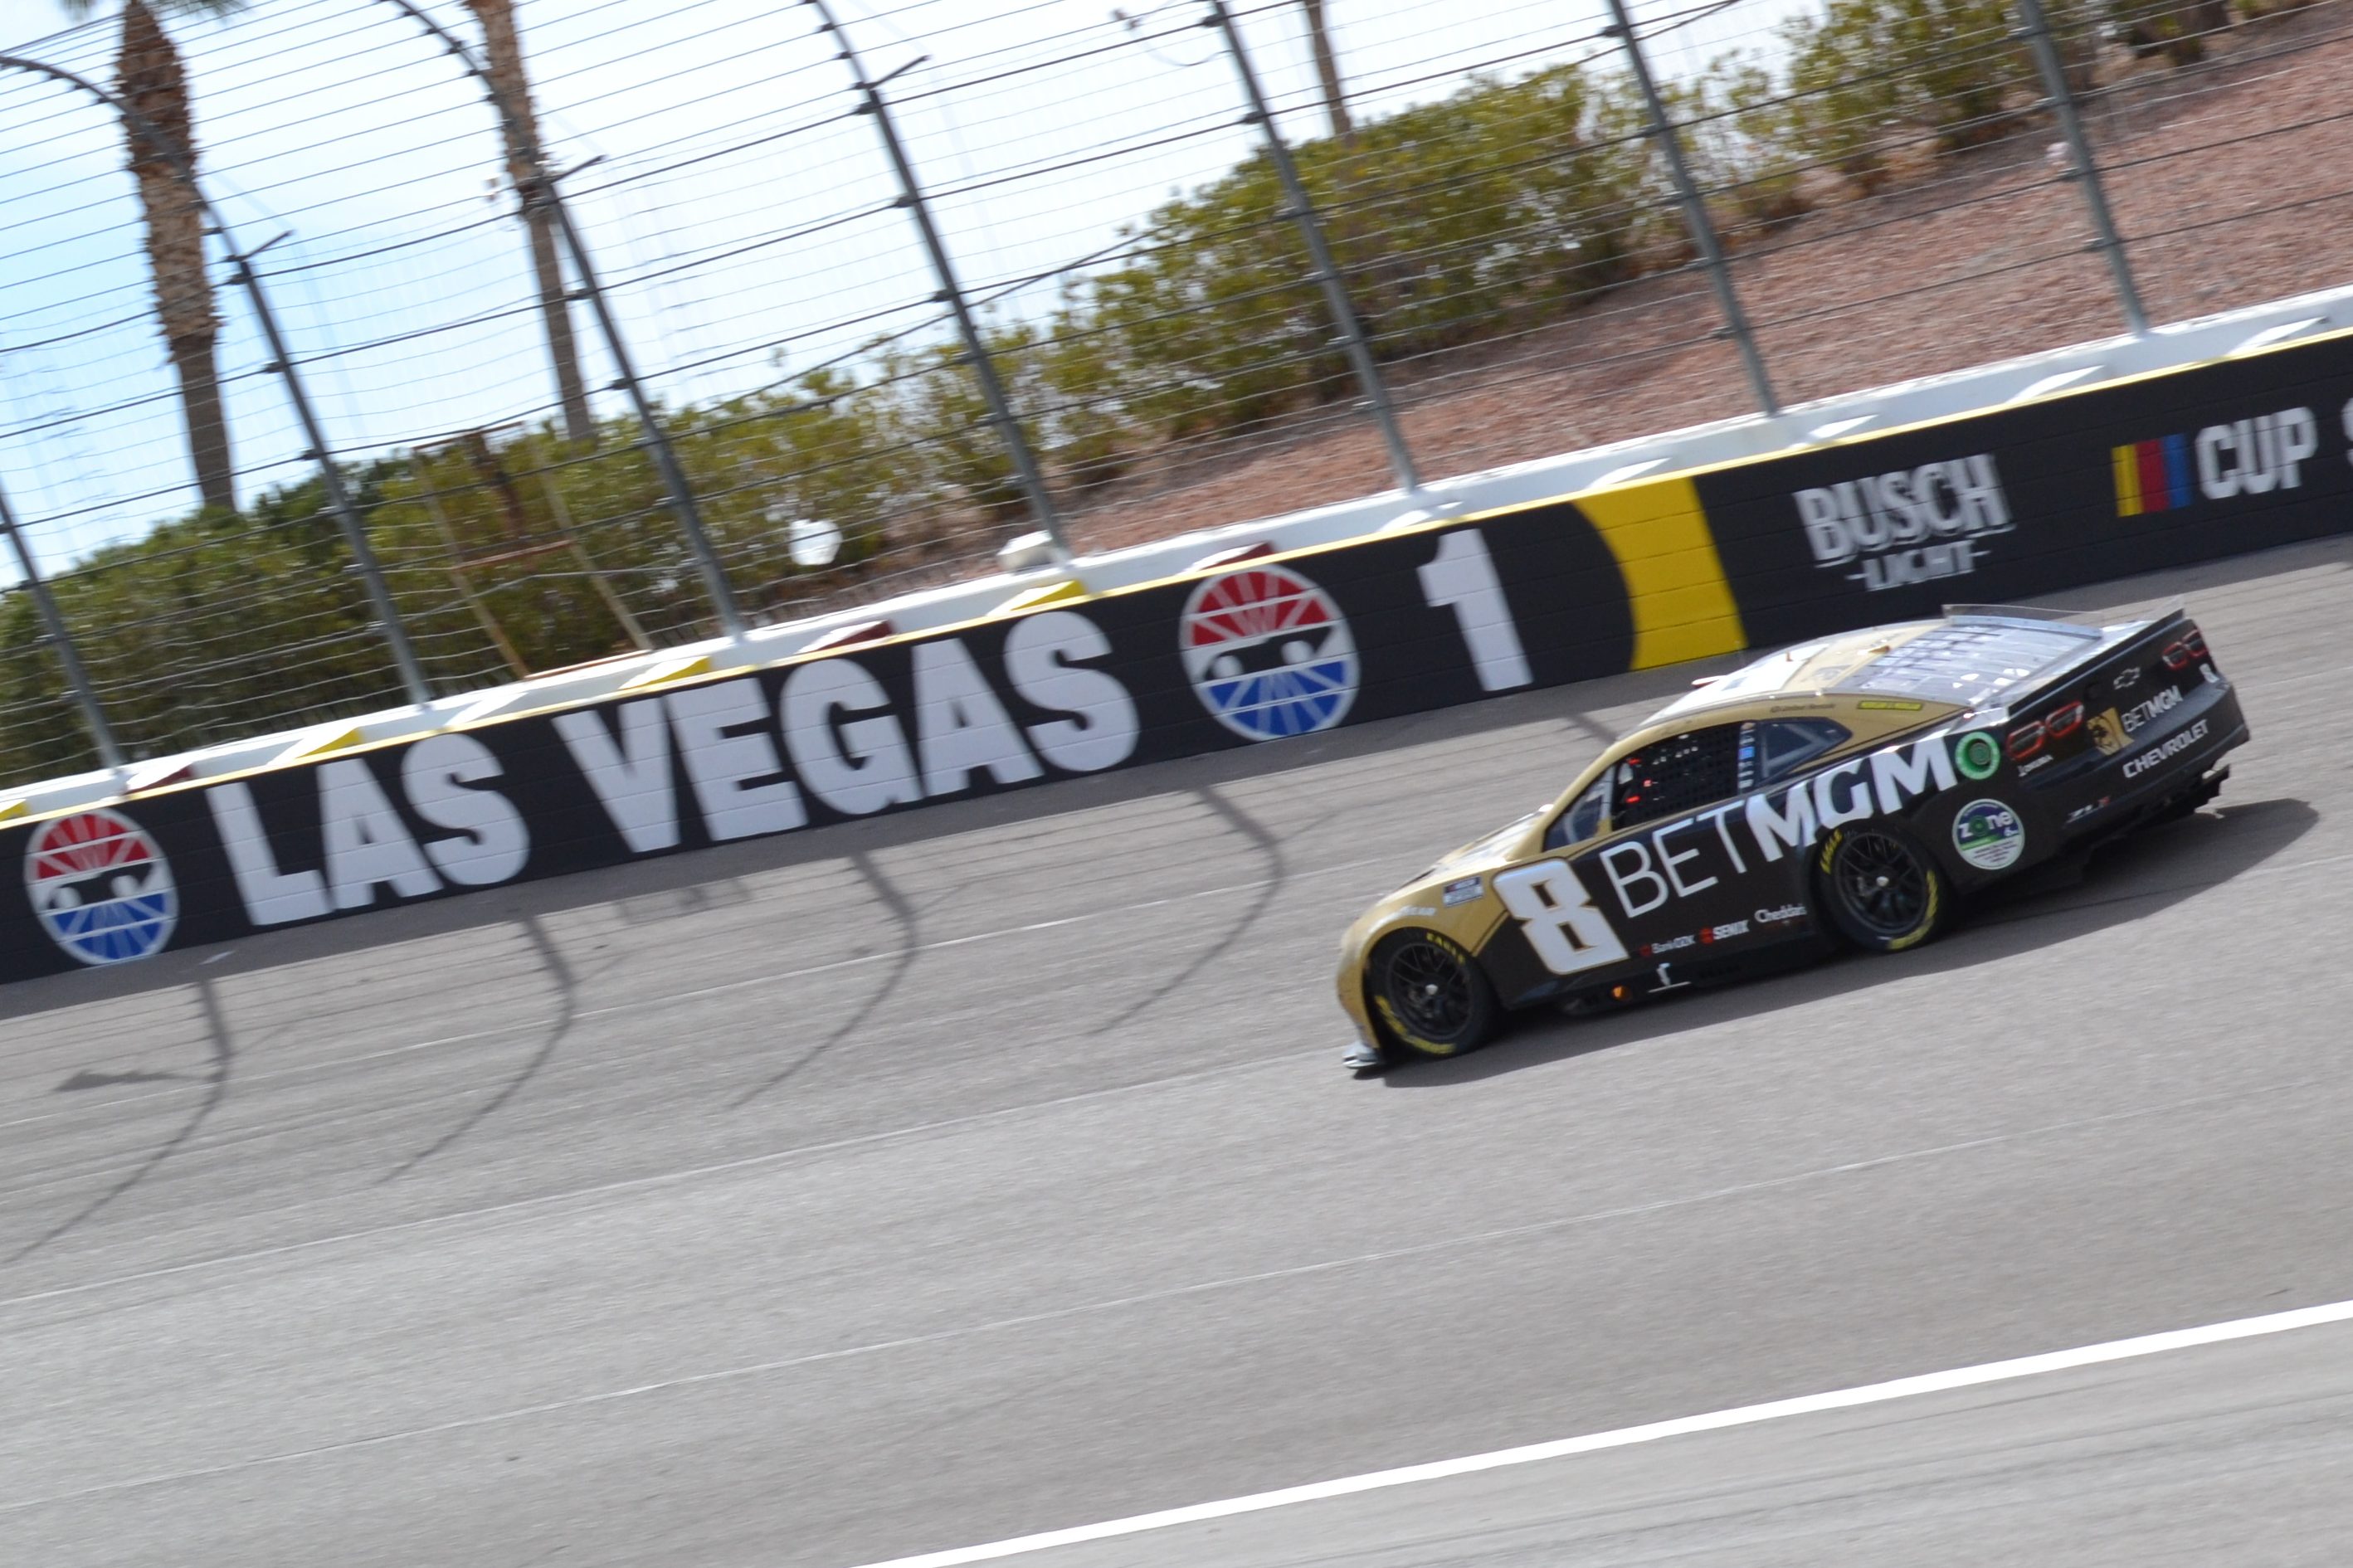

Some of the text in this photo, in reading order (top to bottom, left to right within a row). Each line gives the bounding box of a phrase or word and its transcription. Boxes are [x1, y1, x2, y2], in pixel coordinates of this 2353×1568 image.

[1793, 453, 2015, 567] BUSCH
[2194, 406, 2319, 500] CUP
[1415, 528, 1534, 691] 1
[1862, 539, 1977, 592] LIGHT
[2121, 684, 2184, 733] BETMGM
[2122, 718, 2209, 778] CHEVROLET
[206, 611, 1141, 927] LAS VEGAS
[1600, 733, 1958, 918] BETMGM
[1493, 857, 1630, 975] 8
